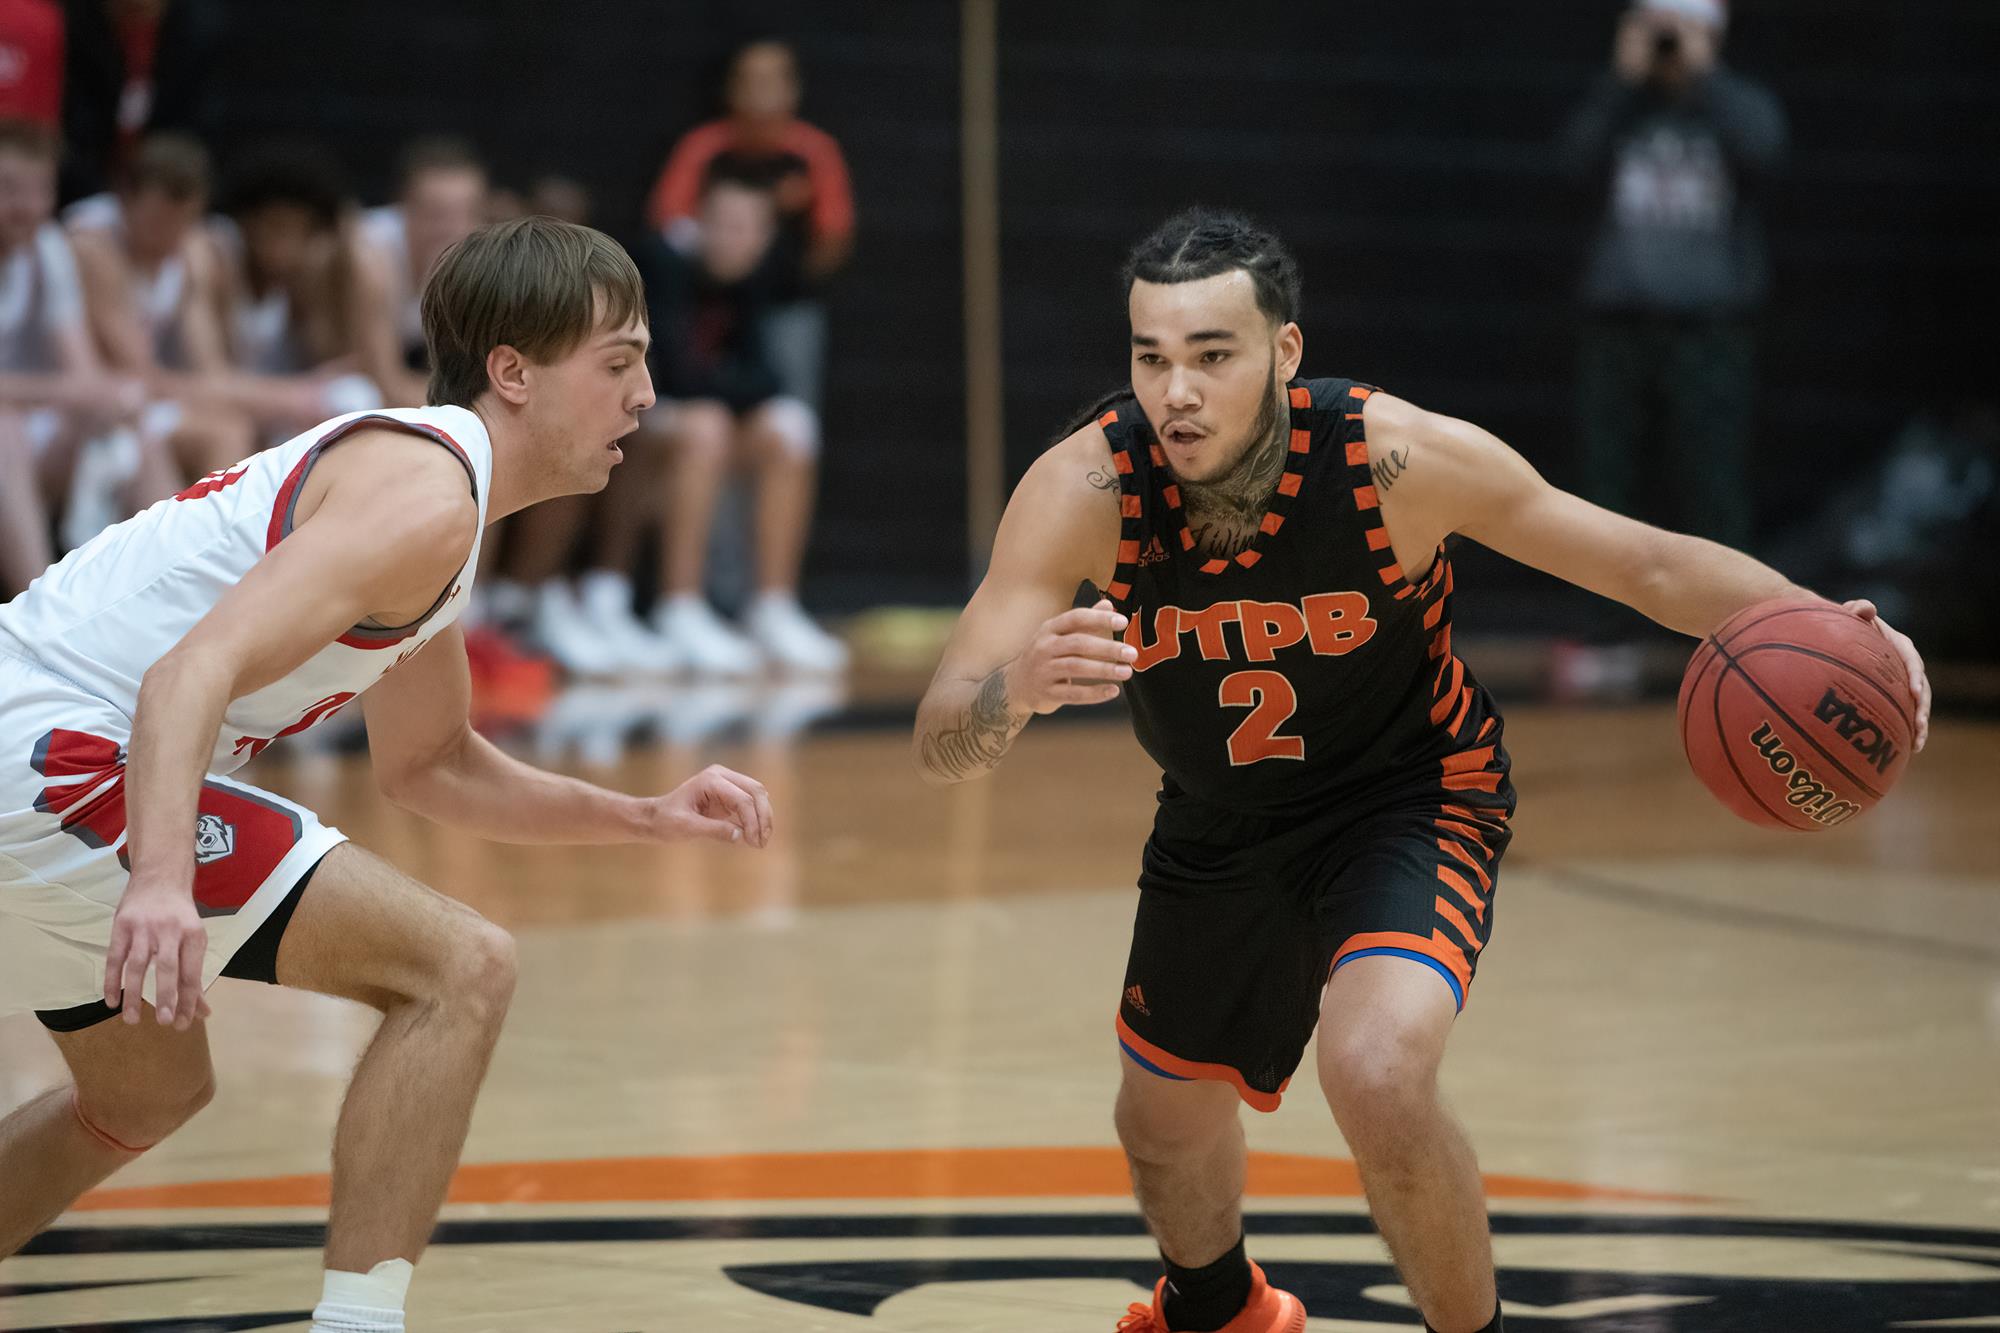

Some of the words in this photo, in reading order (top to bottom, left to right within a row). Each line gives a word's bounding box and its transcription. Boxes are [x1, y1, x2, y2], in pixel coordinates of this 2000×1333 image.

[1123, 591, 1378, 673] UTPB
[1218, 669, 1305, 767] 2
[1814, 687, 1897, 775] NCAA
[1751, 721, 1860, 825] Wilson
